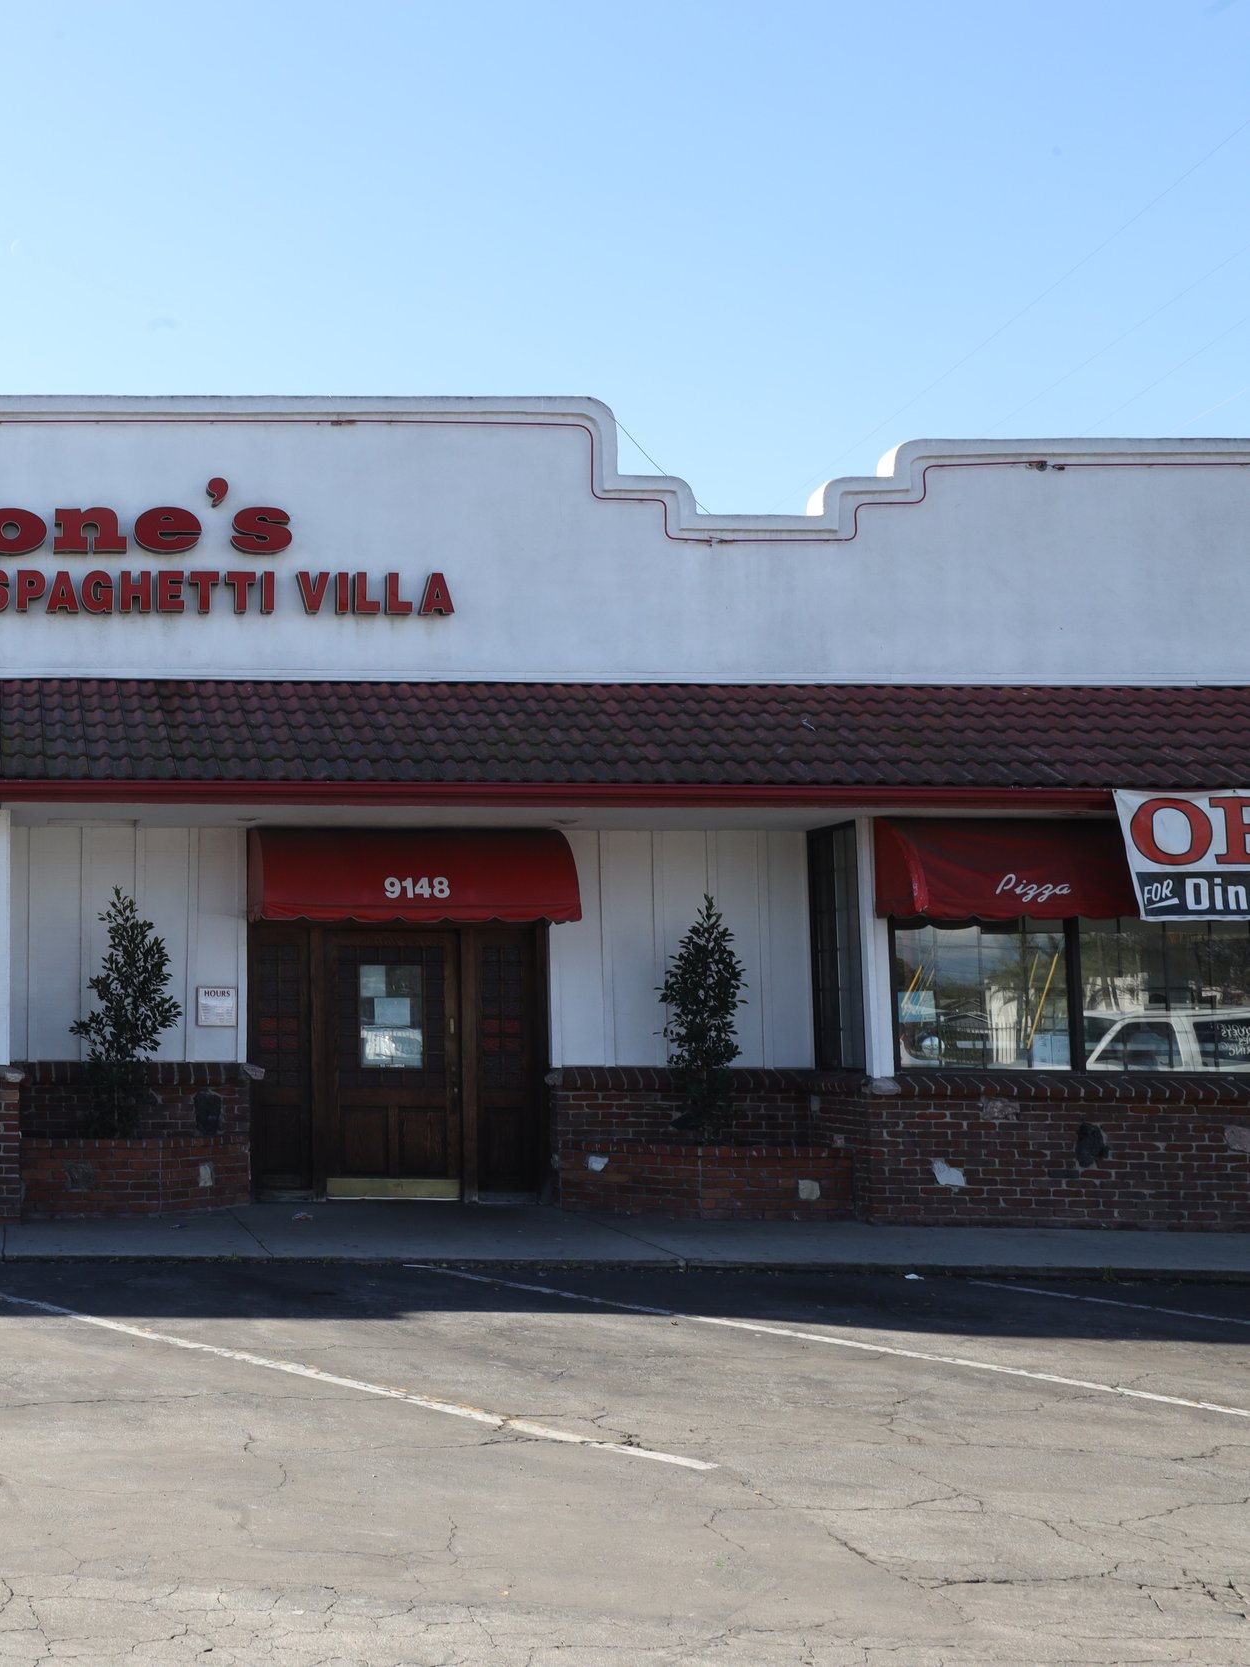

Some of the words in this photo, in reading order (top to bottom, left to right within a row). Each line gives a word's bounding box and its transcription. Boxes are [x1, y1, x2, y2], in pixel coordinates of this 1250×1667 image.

[297, 572, 456, 617] VILLA
[384, 876, 450, 899] 9148
[995, 874, 1071, 902] Pizza
[1143, 878, 1173, 905] FOR
[1185, 878, 1249, 911] Din
[204, 989, 231, 998] HOURS
